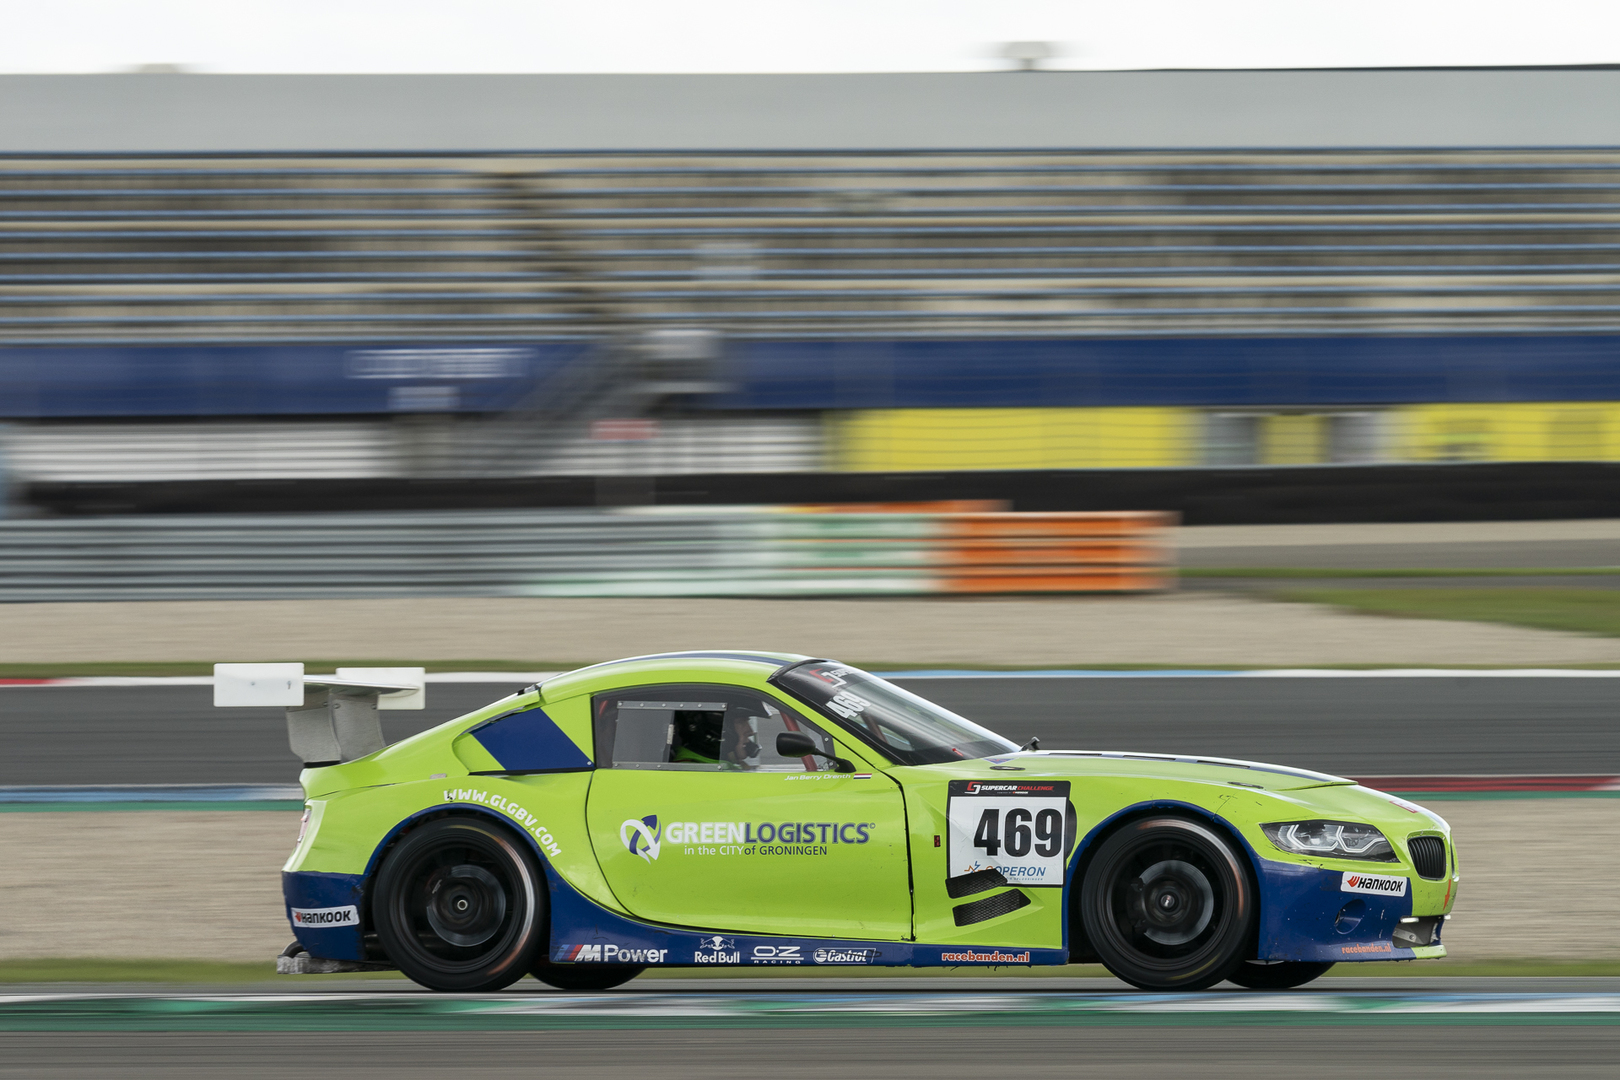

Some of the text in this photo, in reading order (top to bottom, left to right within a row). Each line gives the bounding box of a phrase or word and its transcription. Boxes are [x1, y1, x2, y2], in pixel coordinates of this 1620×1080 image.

[825, 691, 871, 719] 469
[443, 788, 562, 858] WWW.GLGBV.COM
[973, 807, 1063, 858] 469
[684, 845, 695, 856] in
[697, 845, 716, 856] the
[759, 845, 827, 856] GRONINGEN
[827, 949, 868, 962] Castrol
[1341, 943, 1392, 955] racebanden.nl
[941, 950, 1030, 963] racebanden.nl
